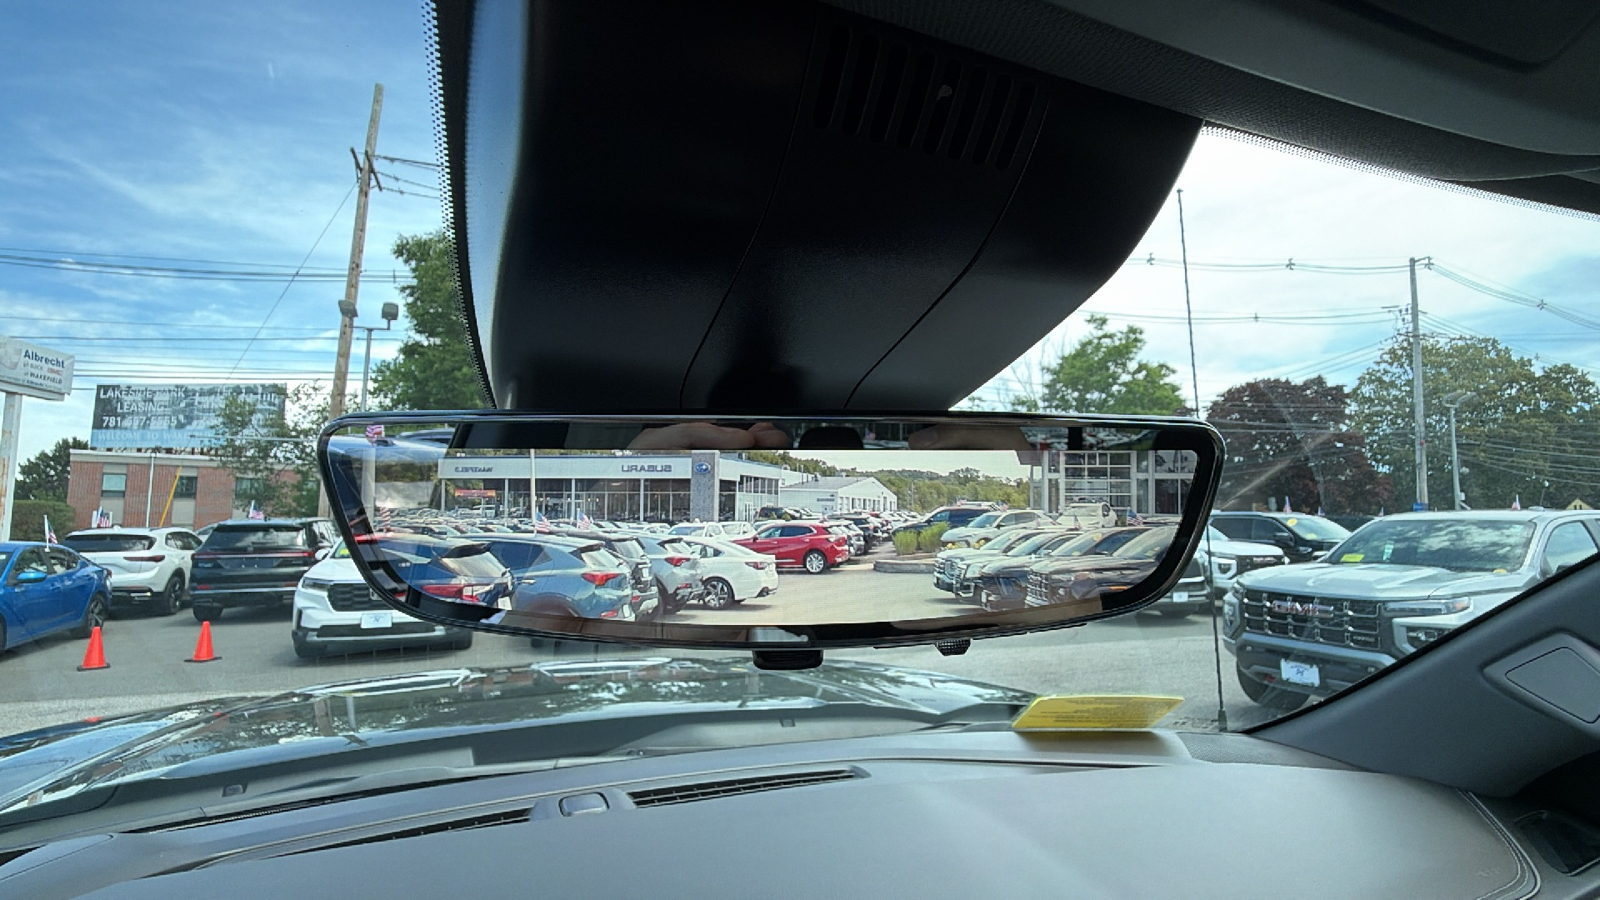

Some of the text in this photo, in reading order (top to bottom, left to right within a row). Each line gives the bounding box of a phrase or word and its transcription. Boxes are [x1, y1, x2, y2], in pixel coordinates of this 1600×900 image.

[23, 349, 65, 369] Albrecht
[30, 371, 63, 384] WAKEFIELD
[117, 401, 166, 412] LEASING
